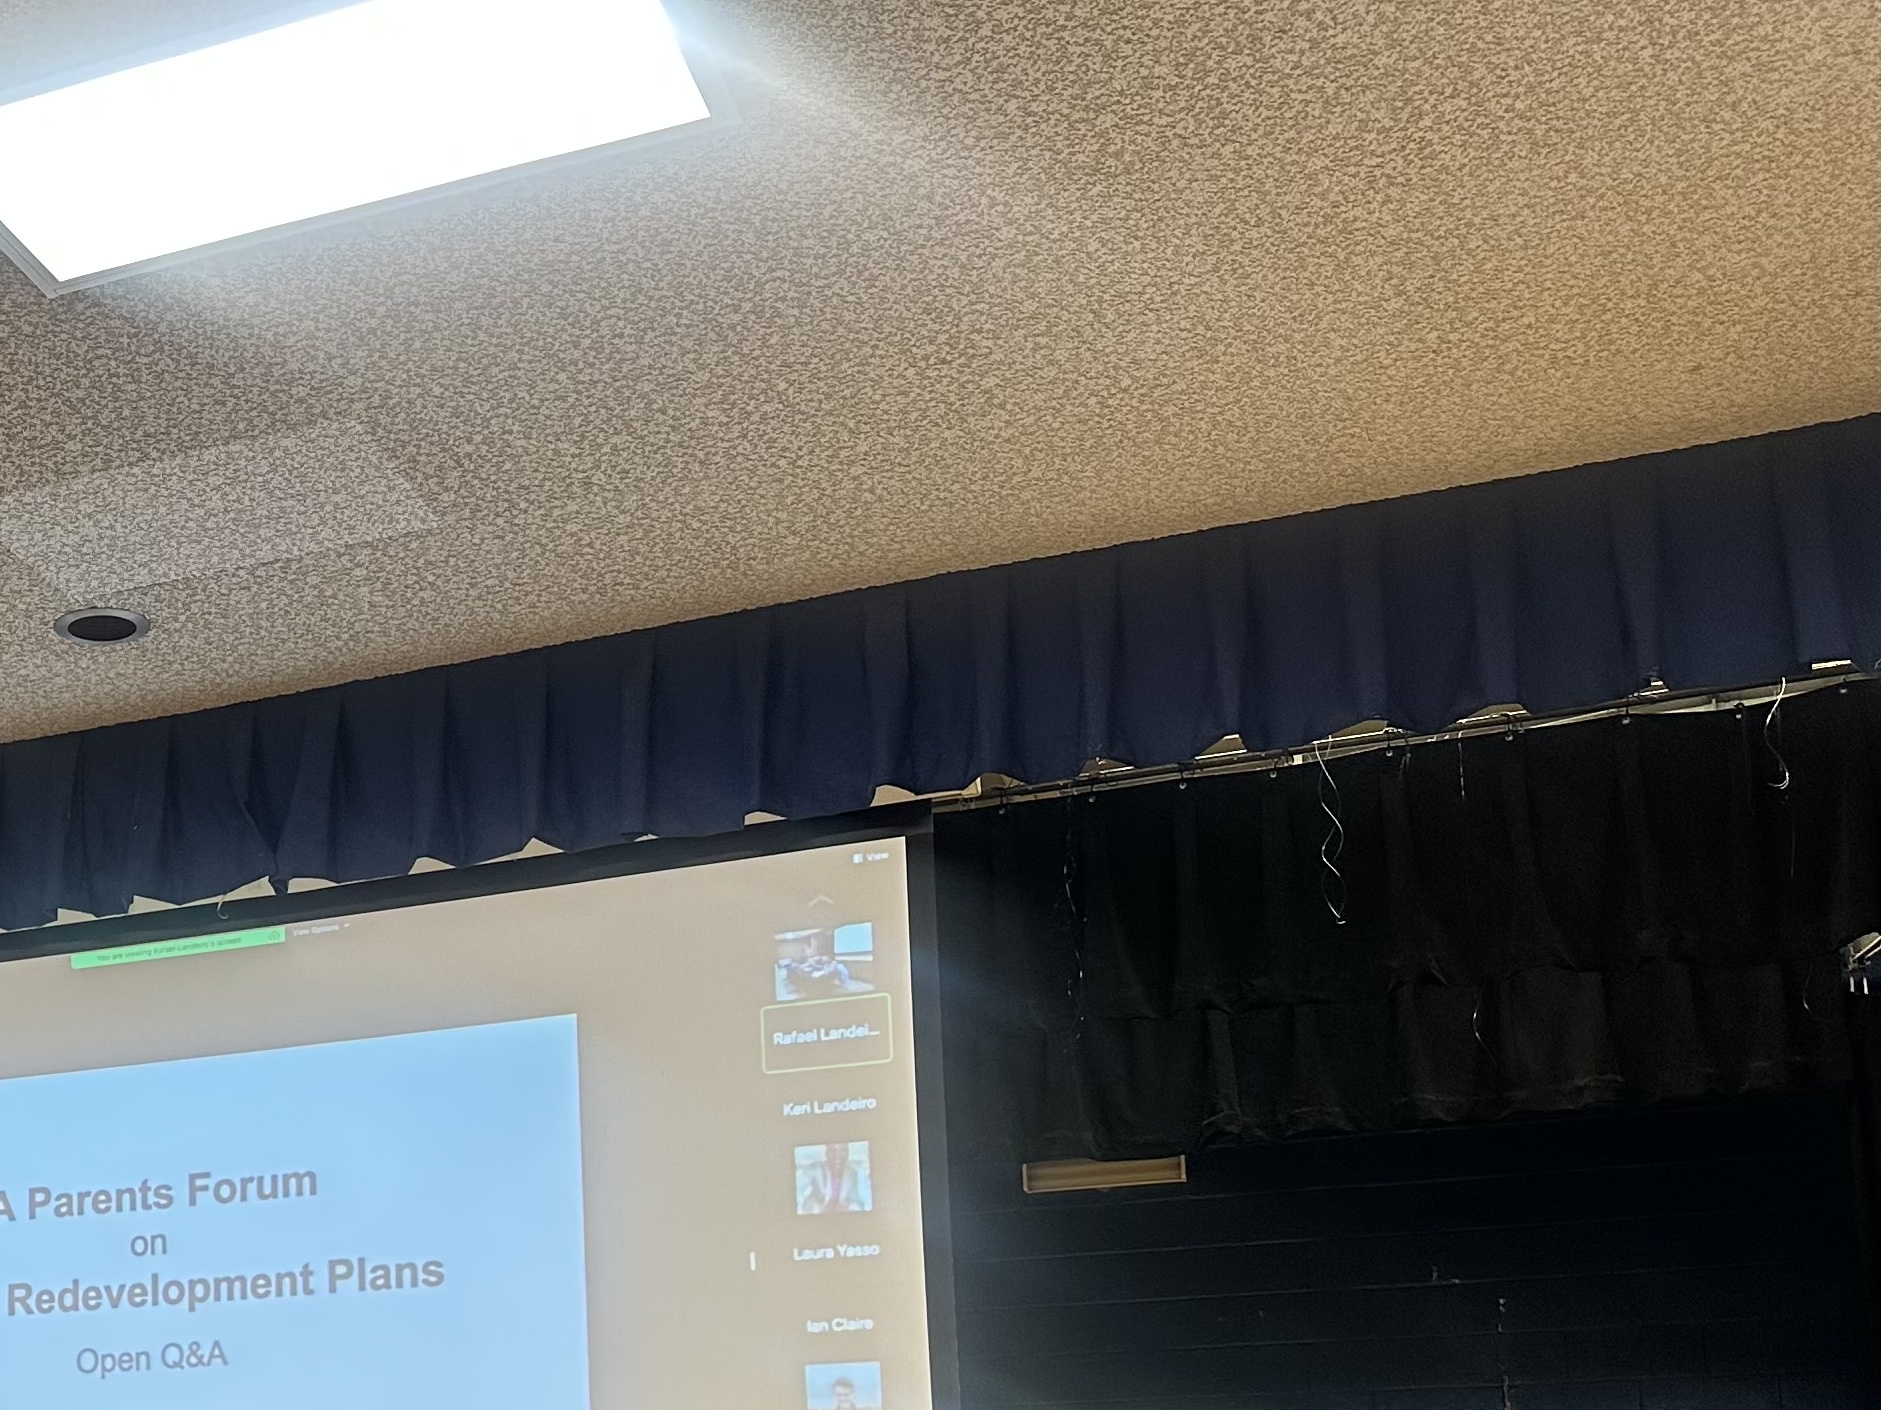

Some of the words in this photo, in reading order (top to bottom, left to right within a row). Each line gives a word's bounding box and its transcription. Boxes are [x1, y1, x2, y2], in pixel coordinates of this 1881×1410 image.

[773, 1028, 818, 1045] Rafael
[813, 1096, 877, 1114] Landeiro
[27, 1177, 174, 1220] Parents
[187, 1170, 318, 1207] Forum
[130, 1233, 167, 1257] on
[793, 1247, 835, 1260] Laura
[7, 1262, 314, 1316] Redevelopment
[327, 1256, 445, 1294] Plans
[831, 1317, 874, 1331] Claire
[76, 1346, 151, 1380] Open
[160, 1339, 229, 1371] Q&A
